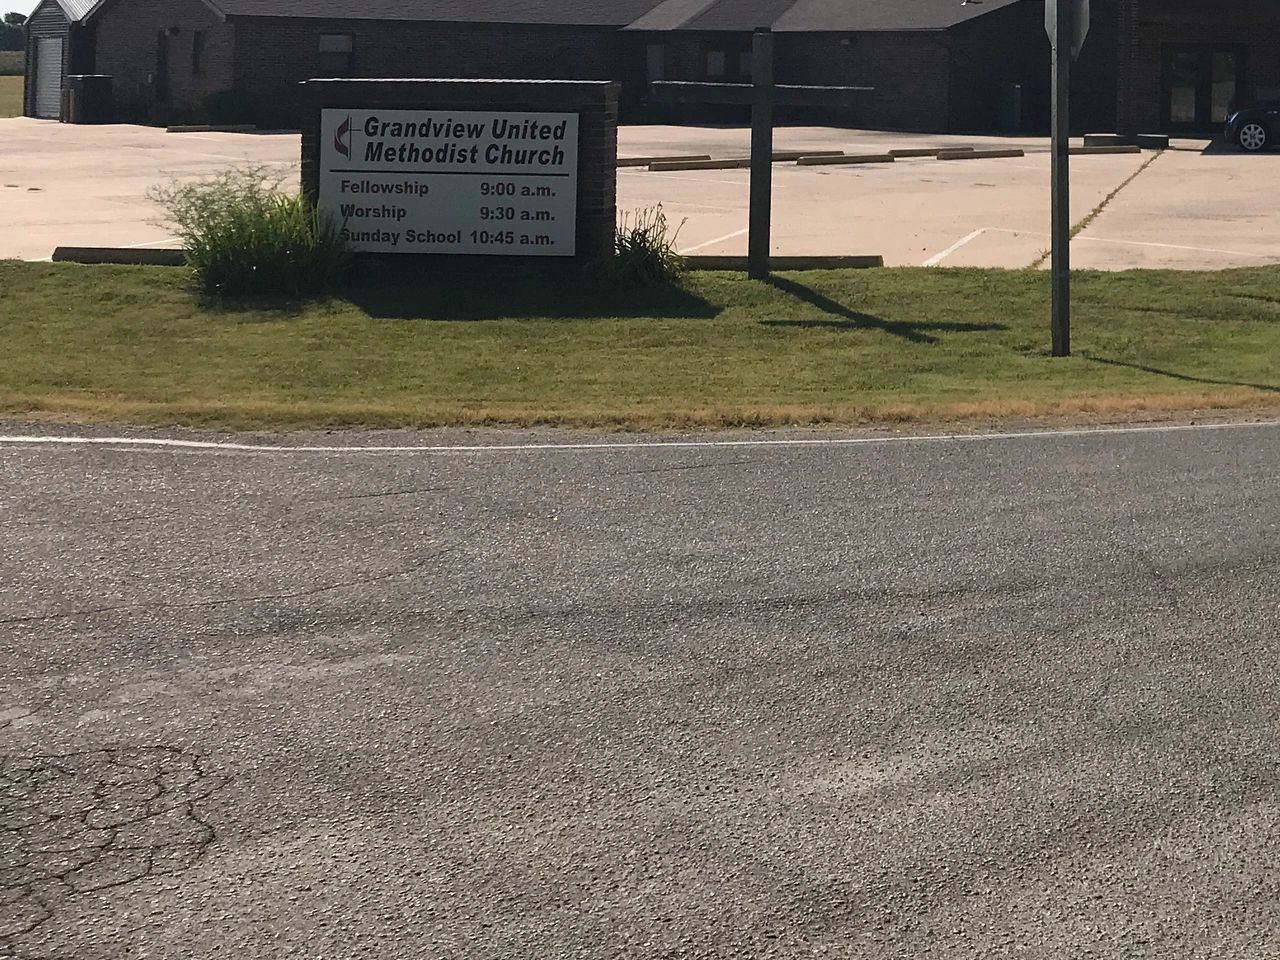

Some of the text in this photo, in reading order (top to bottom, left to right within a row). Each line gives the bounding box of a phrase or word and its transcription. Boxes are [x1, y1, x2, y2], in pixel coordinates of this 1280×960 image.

[364, 116, 567, 140] Grandview United
[365, 142, 564, 165] Methodist Church
[341, 180, 556, 197] Fellowship 9:00 a.m.
[341, 205, 555, 221] Worship 9:30 a.m.
[340, 229, 554, 245] Sunday School 10:45 a.m.
